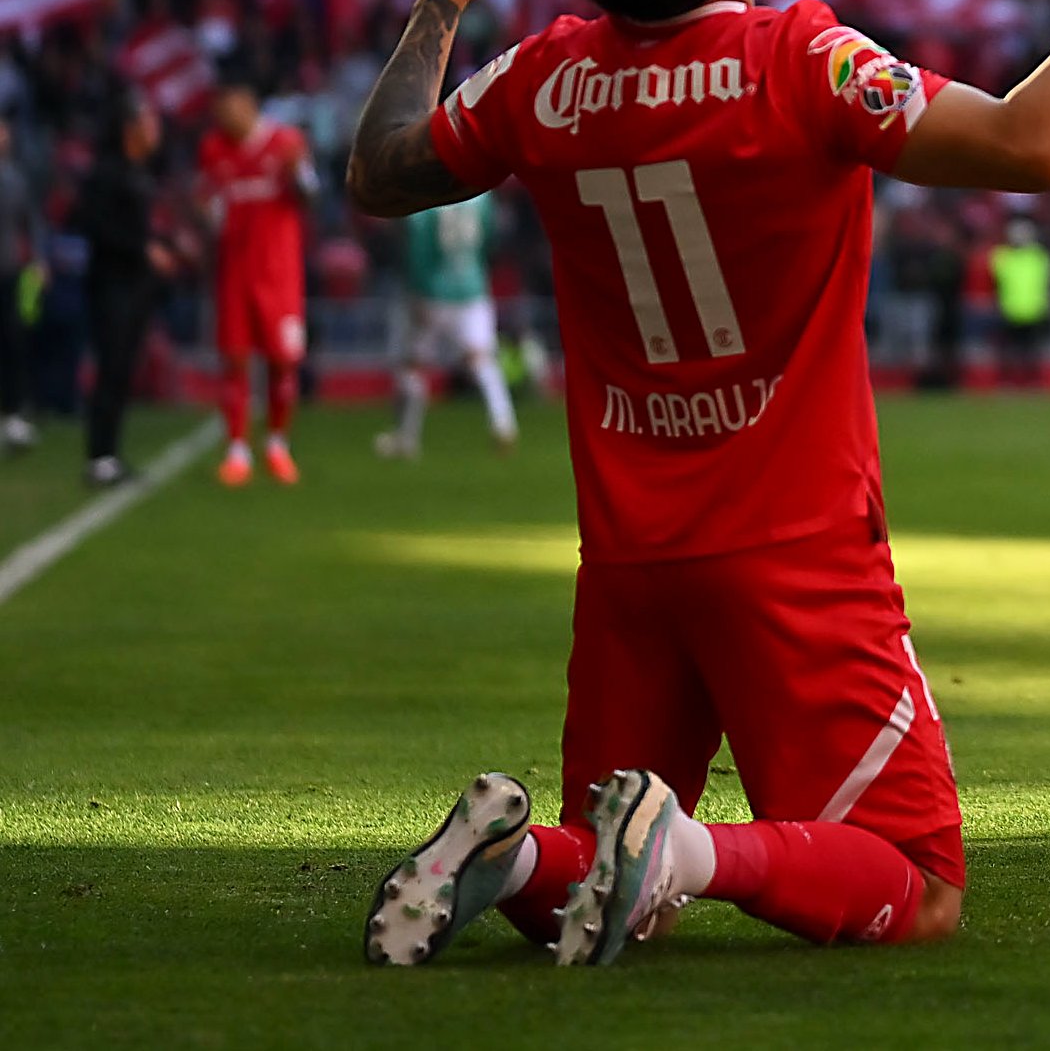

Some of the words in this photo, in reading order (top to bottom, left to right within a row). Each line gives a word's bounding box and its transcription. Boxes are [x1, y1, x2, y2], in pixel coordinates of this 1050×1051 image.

[534, 56, 744, 135] Corona
[575, 159, 746, 364] 11
[601, 384, 643, 434] M.
